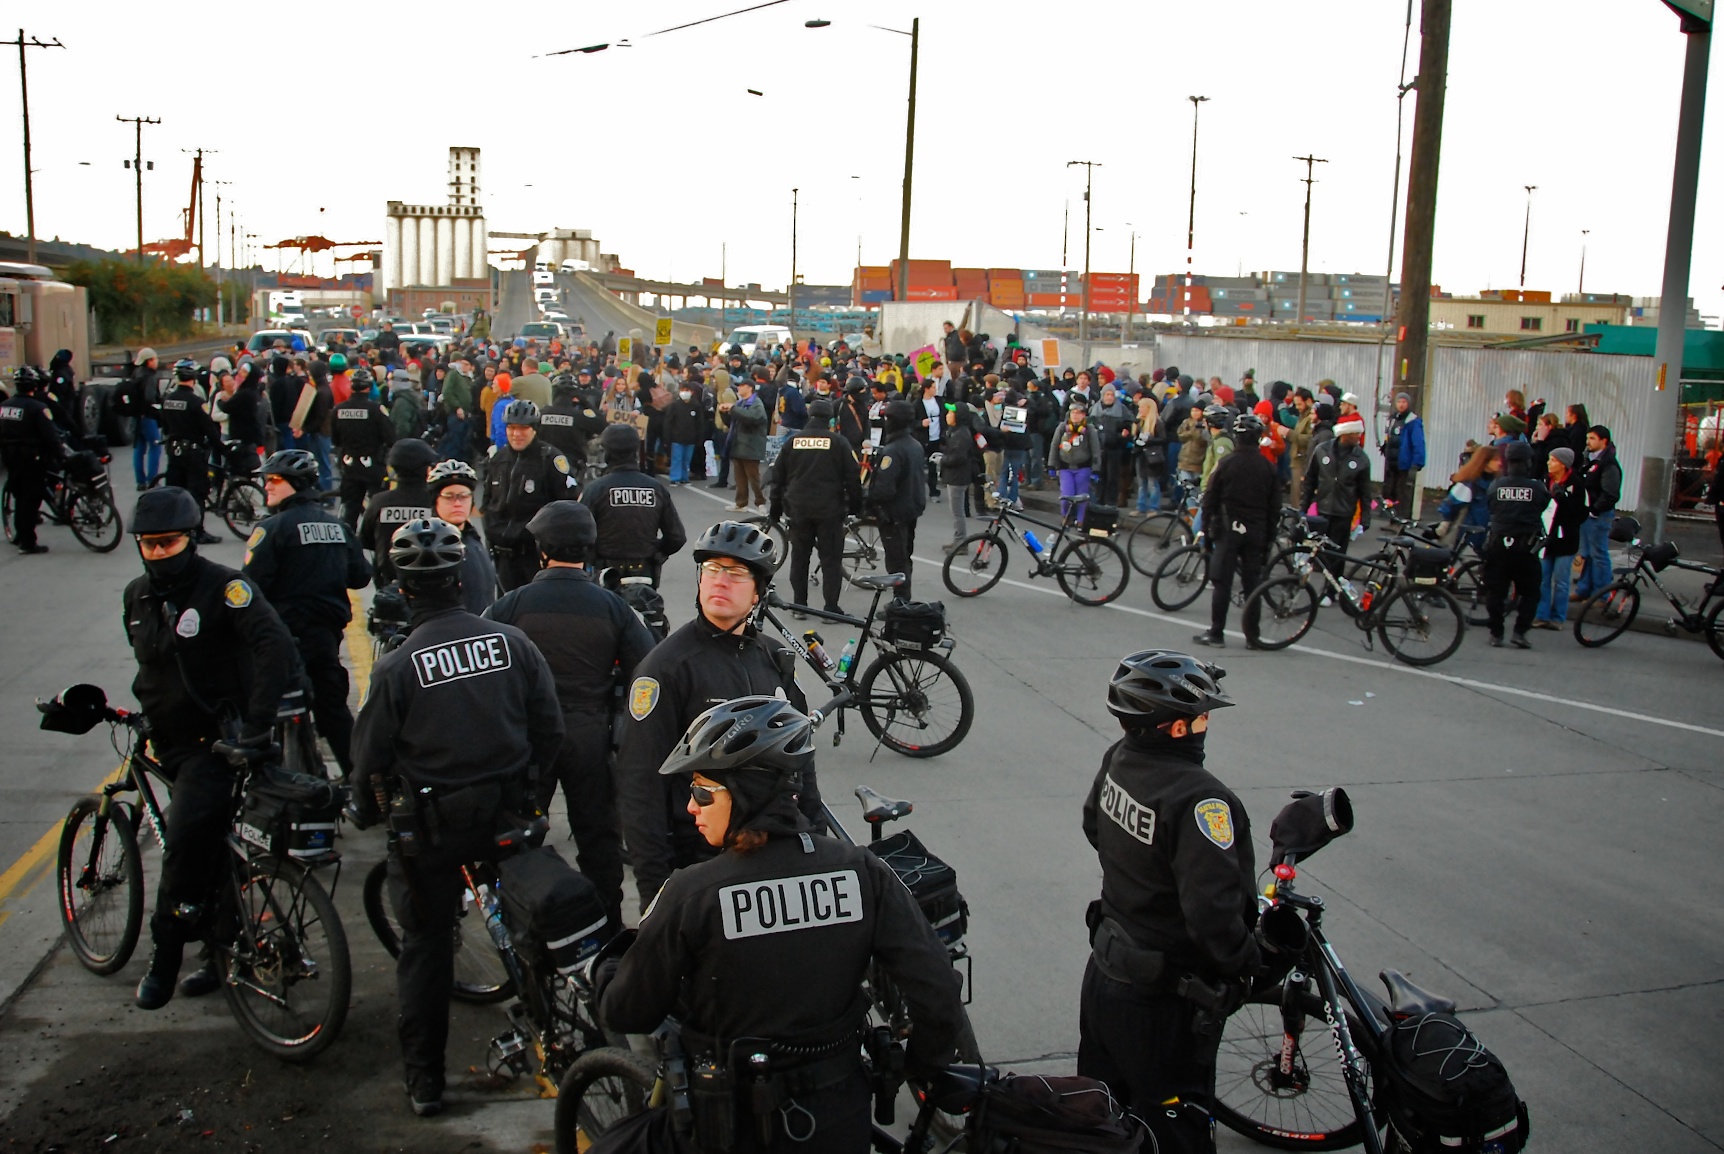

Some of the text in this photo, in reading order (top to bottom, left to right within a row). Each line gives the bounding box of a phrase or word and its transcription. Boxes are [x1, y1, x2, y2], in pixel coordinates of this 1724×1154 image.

[340, 410, 364, 418] POLICE
[544, 416, 569, 424] POLICE
[794, 439, 829, 448] POLICE
[613, 489, 652, 505] POLICE
[1500, 488, 1530, 500] POLICE
[386, 509, 425, 520] POLICE
[303, 524, 342, 541] POLICE
[420, 638, 504, 681] POLICE
[726, 714, 754, 739] GIRO
[1102, 779, 1152, 840] POLICE
[731, 875, 852, 933] POLICE
